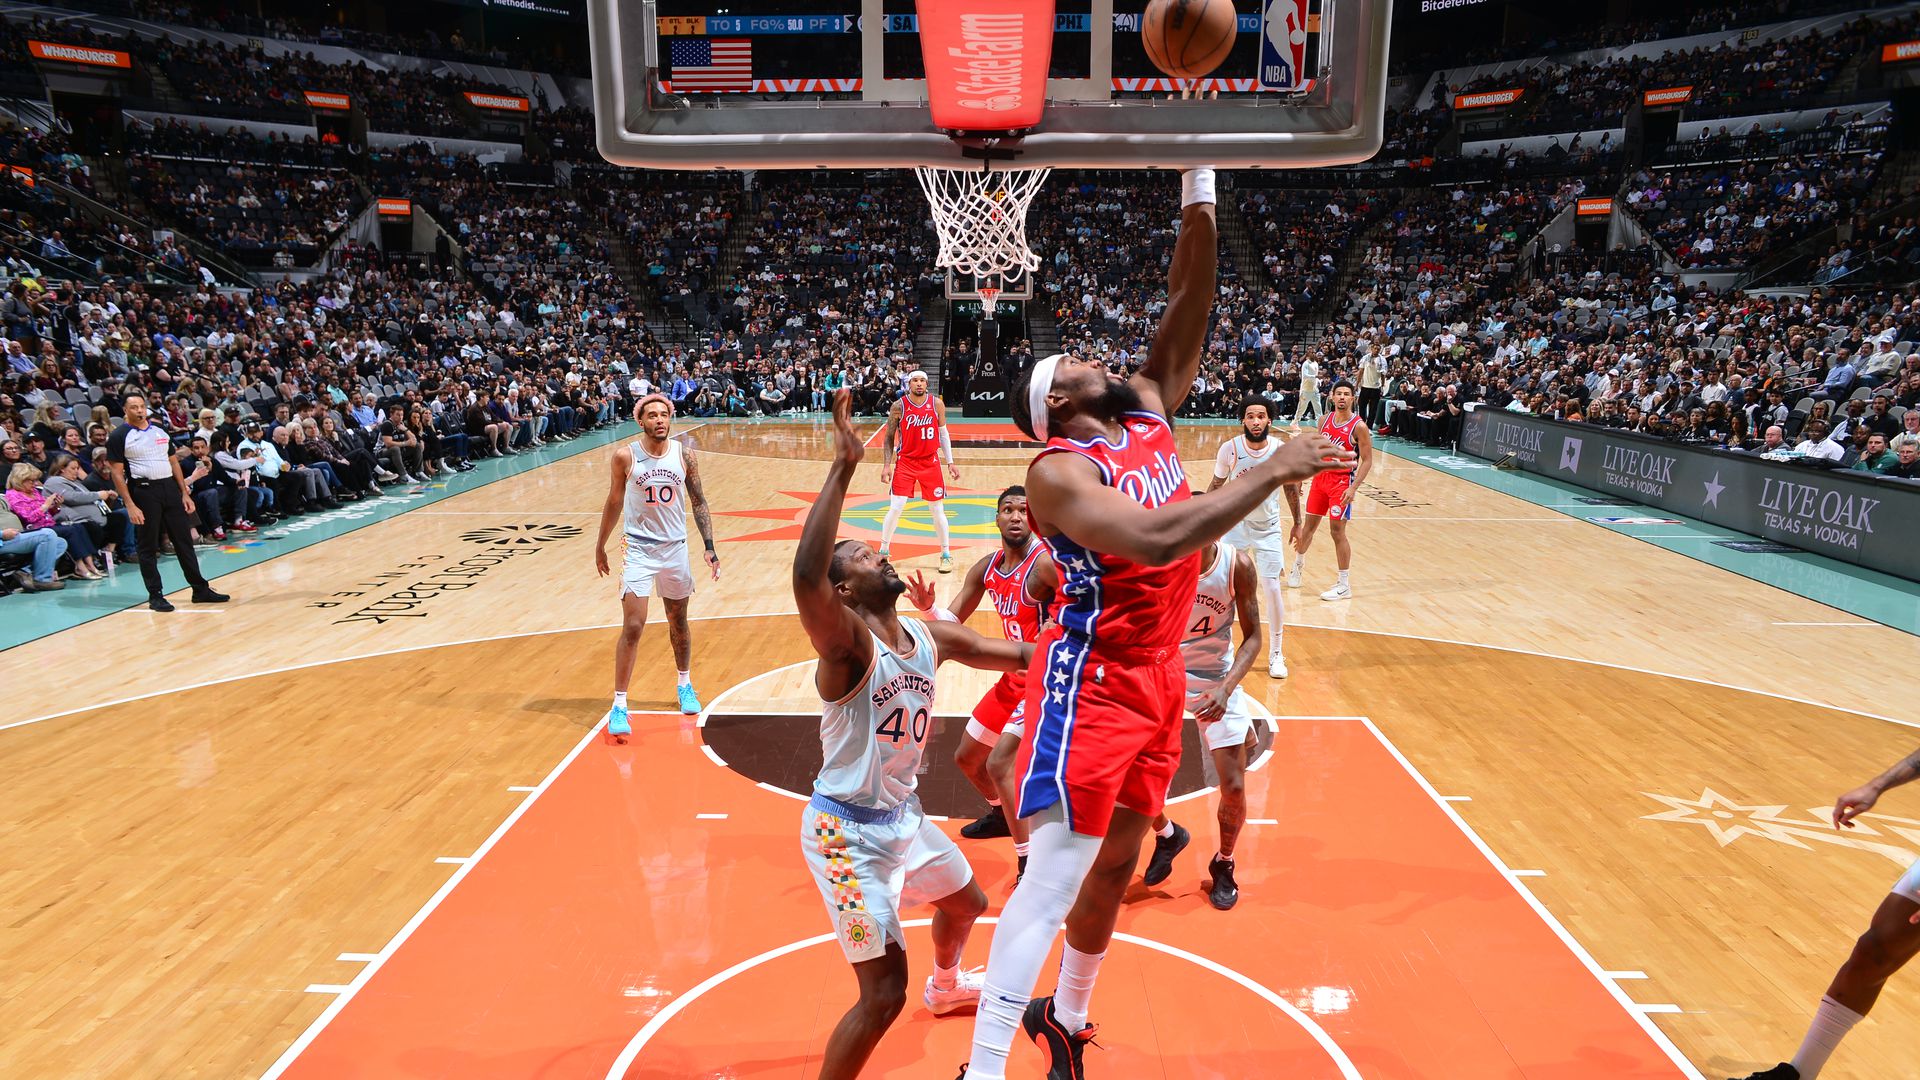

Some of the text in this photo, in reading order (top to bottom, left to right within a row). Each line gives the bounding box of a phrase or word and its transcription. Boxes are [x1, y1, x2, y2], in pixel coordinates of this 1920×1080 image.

[711, 19, 840, 32] TO 5 FG% 50.0 PF 3
[1056, 15, 1084, 30] PHI
[1239, 18, 1259, 29] TO
[41, 44, 118, 65] WHATABURGER
[1265, 66, 1287, 83] NBA
[470, 95, 521, 109] WHATABURGER
[1463, 93, 1514, 106] WHATABURGER
[905, 413, 934, 431] Phila
[921, 426, 935, 440] 18
[1495, 422, 1521, 446] LIVE
[1520, 427, 1545, 453] OAK
[1601, 444, 1677, 485] LIVE OAK
[635, 468, 682, 487] SAN ANTONIO
[1116, 450, 1185, 509] Phila
[1605, 472, 1664, 498] TEXAS VODKA
[645, 485, 674, 504] 10
[1758, 477, 1881, 533] LIVE OAK
[1763, 512, 1801, 535] TEXAS
[1814, 524, 1858, 549] VODKA
[305, 554, 445, 609] CENTER
[331, 547, 543, 625] Frost Bank
[987, 588, 1019, 616] Phila
[1003, 618, 1023, 642] 19
[1190, 615, 1212, 635] 4
[871, 678, 901, 708] SAN
[875, 707, 928, 744] 40
